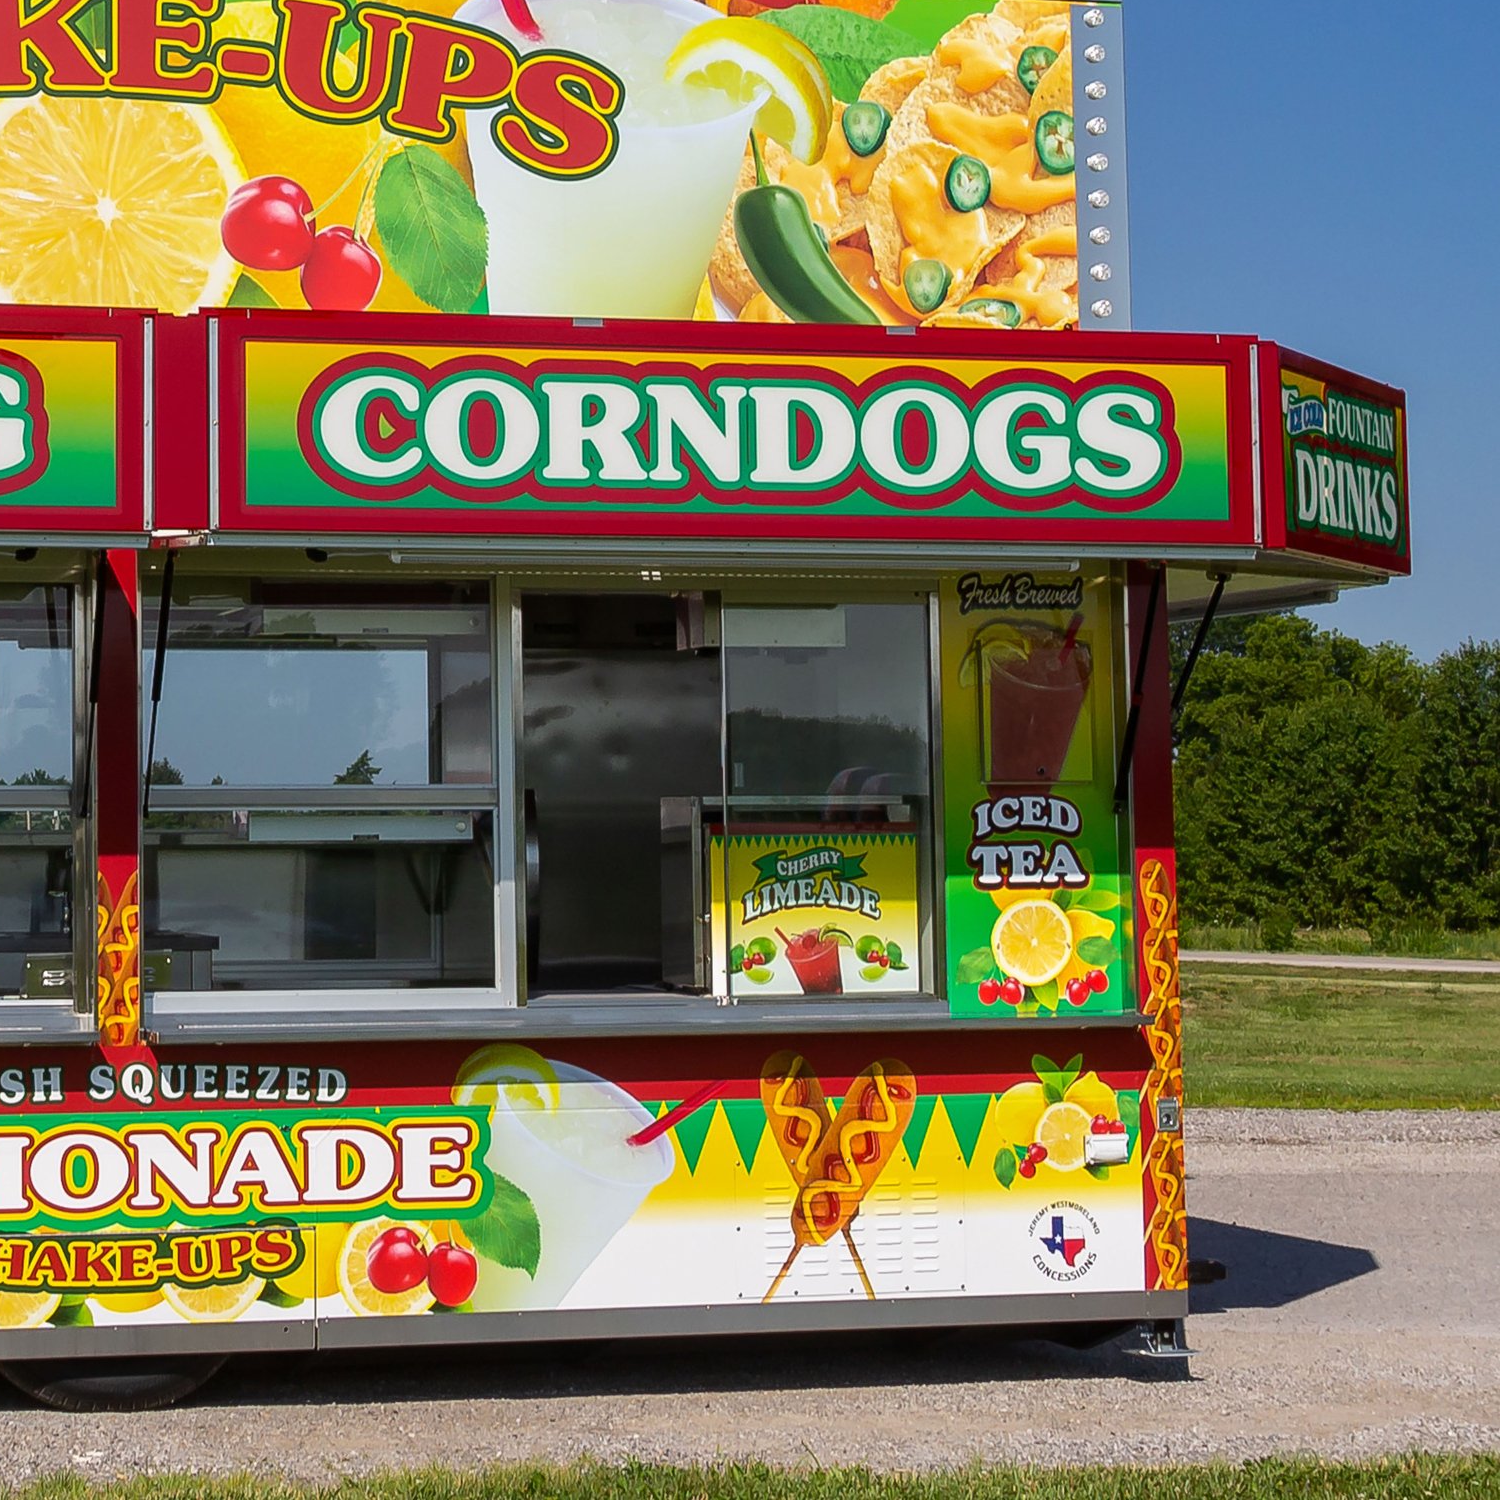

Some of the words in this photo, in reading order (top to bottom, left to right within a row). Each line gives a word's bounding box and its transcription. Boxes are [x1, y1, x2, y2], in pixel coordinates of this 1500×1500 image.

[316, 372, 1169, 493] CORNDOGS
[1327, 397, 1394, 453] FOUNTAIN
[1295, 448, 1399, 541] DRINKS
[961, 575, 1012, 610] Fresh
[1013, 575, 1081, 607] Brewed
[973, 796, 1082, 837] ICED
[776, 851, 843, 876] CHERRY
[972, 844, 1086, 885] TEA
[743, 877, 881, 923] LIMEADE
[88, 1062, 348, 1104] SQUEEZED
[1028, 1206, 1049, 1237] JEREMY
[1050, 1200, 1101, 1235] WESTMORELAND
[1032, 1252, 1097, 1282] CONCESSIONS
